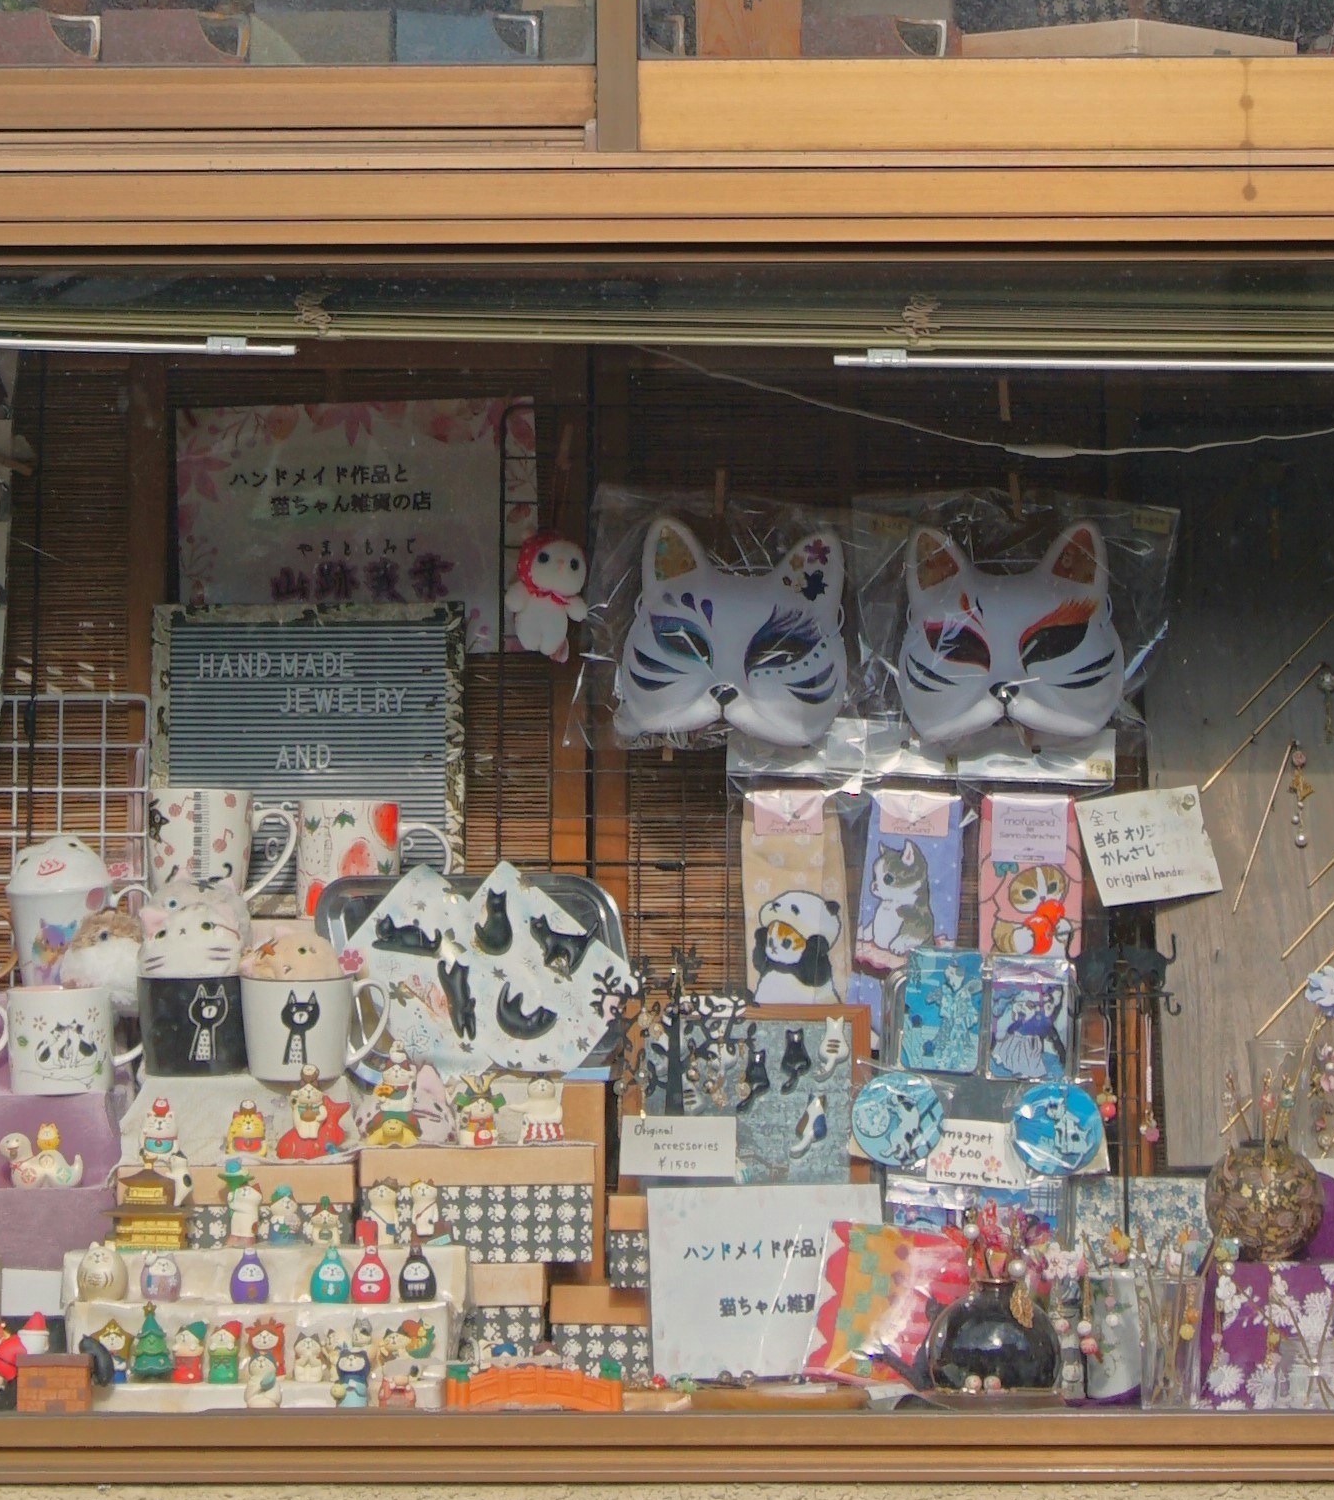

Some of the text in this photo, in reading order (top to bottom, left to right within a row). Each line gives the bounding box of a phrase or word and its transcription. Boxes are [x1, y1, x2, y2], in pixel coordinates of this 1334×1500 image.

[229, 464, 409, 487] ハンドメイド作品と
[270, 491, 432, 517] 猫ちゃん雑貨の店
[279, 687, 408, 714] JEWELRY
[275, 744, 332, 770] AND
[1004, 817, 1056, 827] mofusand
[1089, 809, 1120, 828] 全て
[653, 1141, 720, 1153] accessories
[949, 1145, 982, 1159] ¥600
[657, 1159, 697, 1170] ¥1500
